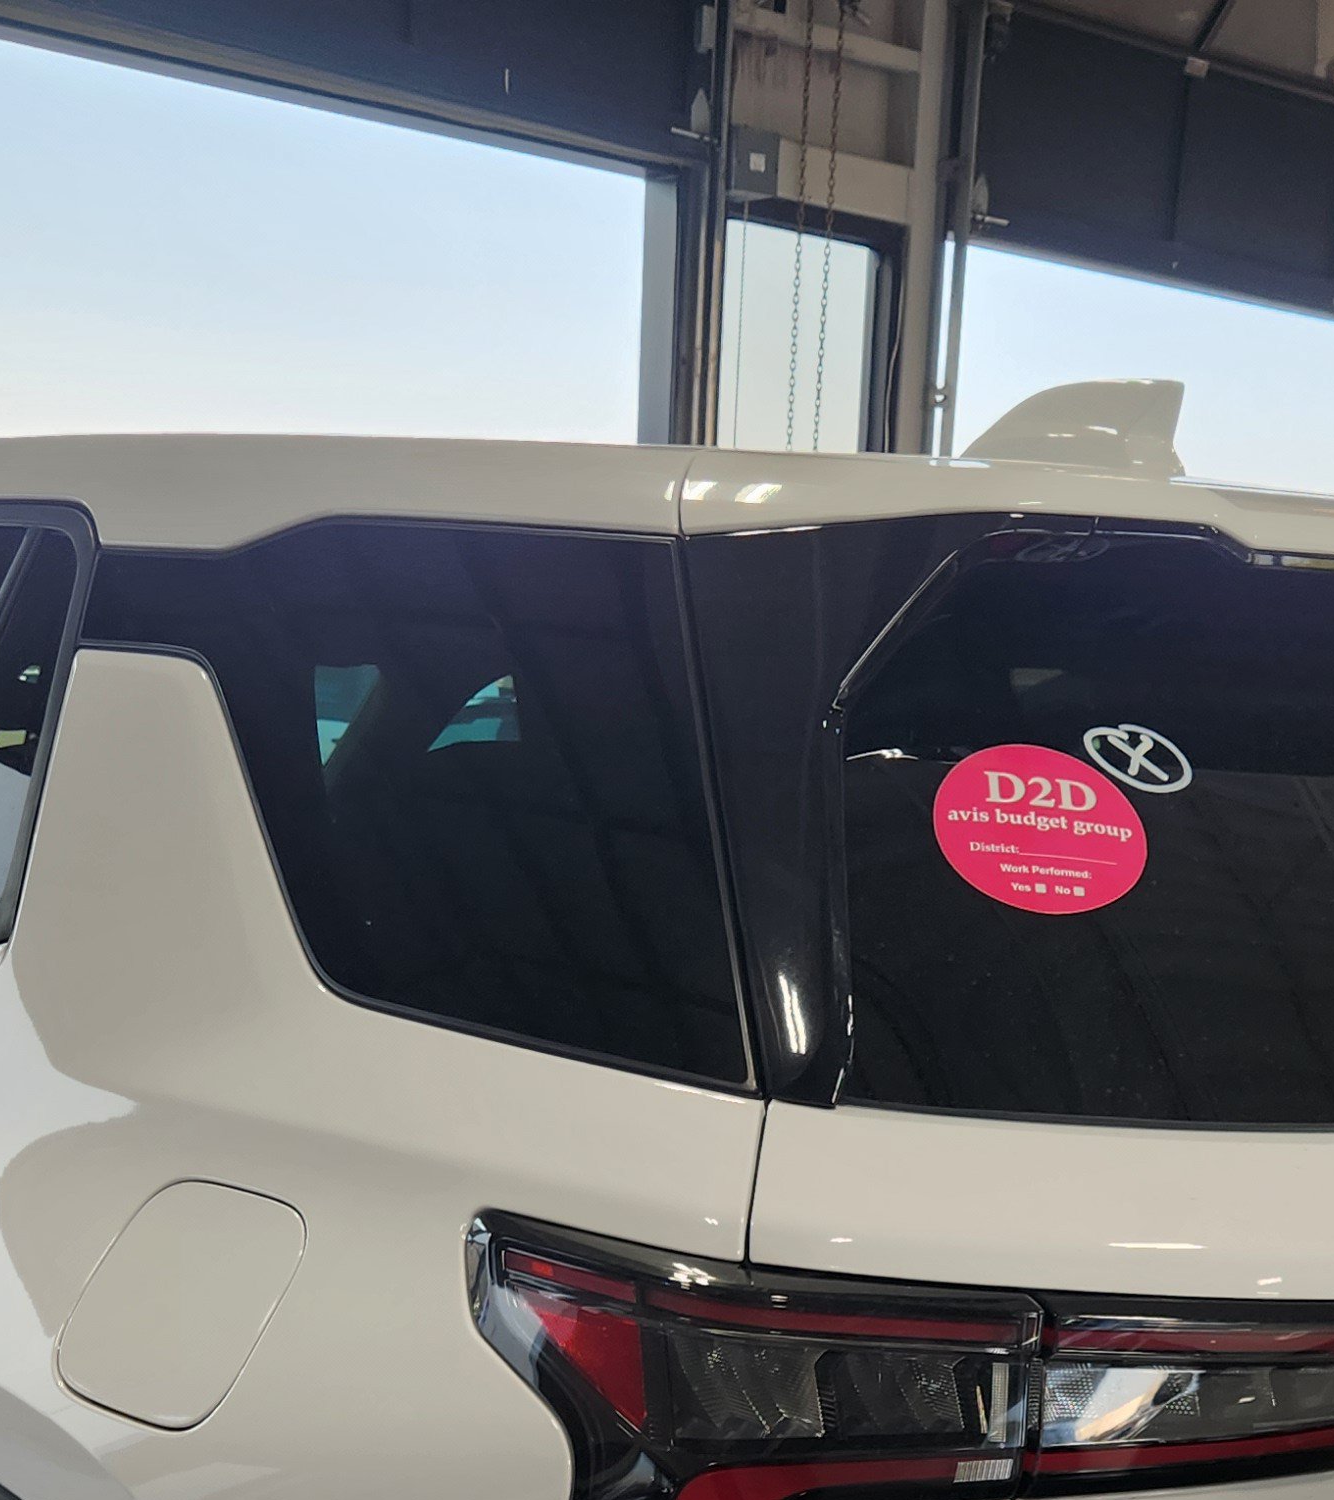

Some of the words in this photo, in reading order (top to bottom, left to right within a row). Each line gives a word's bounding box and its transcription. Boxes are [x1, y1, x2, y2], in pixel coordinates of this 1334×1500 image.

[983, 770, 1098, 813] D2D
[947, 806, 991, 823] avis
[994, 808, 1069, 832] budget
[1072, 819, 1133, 843] group
[969, 841, 1020, 855] District:
[999, 863, 1030, 874] Work
[1031, 865, 1093, 880] Performed:
[1011, 882, 1032, 893] Yes
[1054, 885, 1072, 896] No
